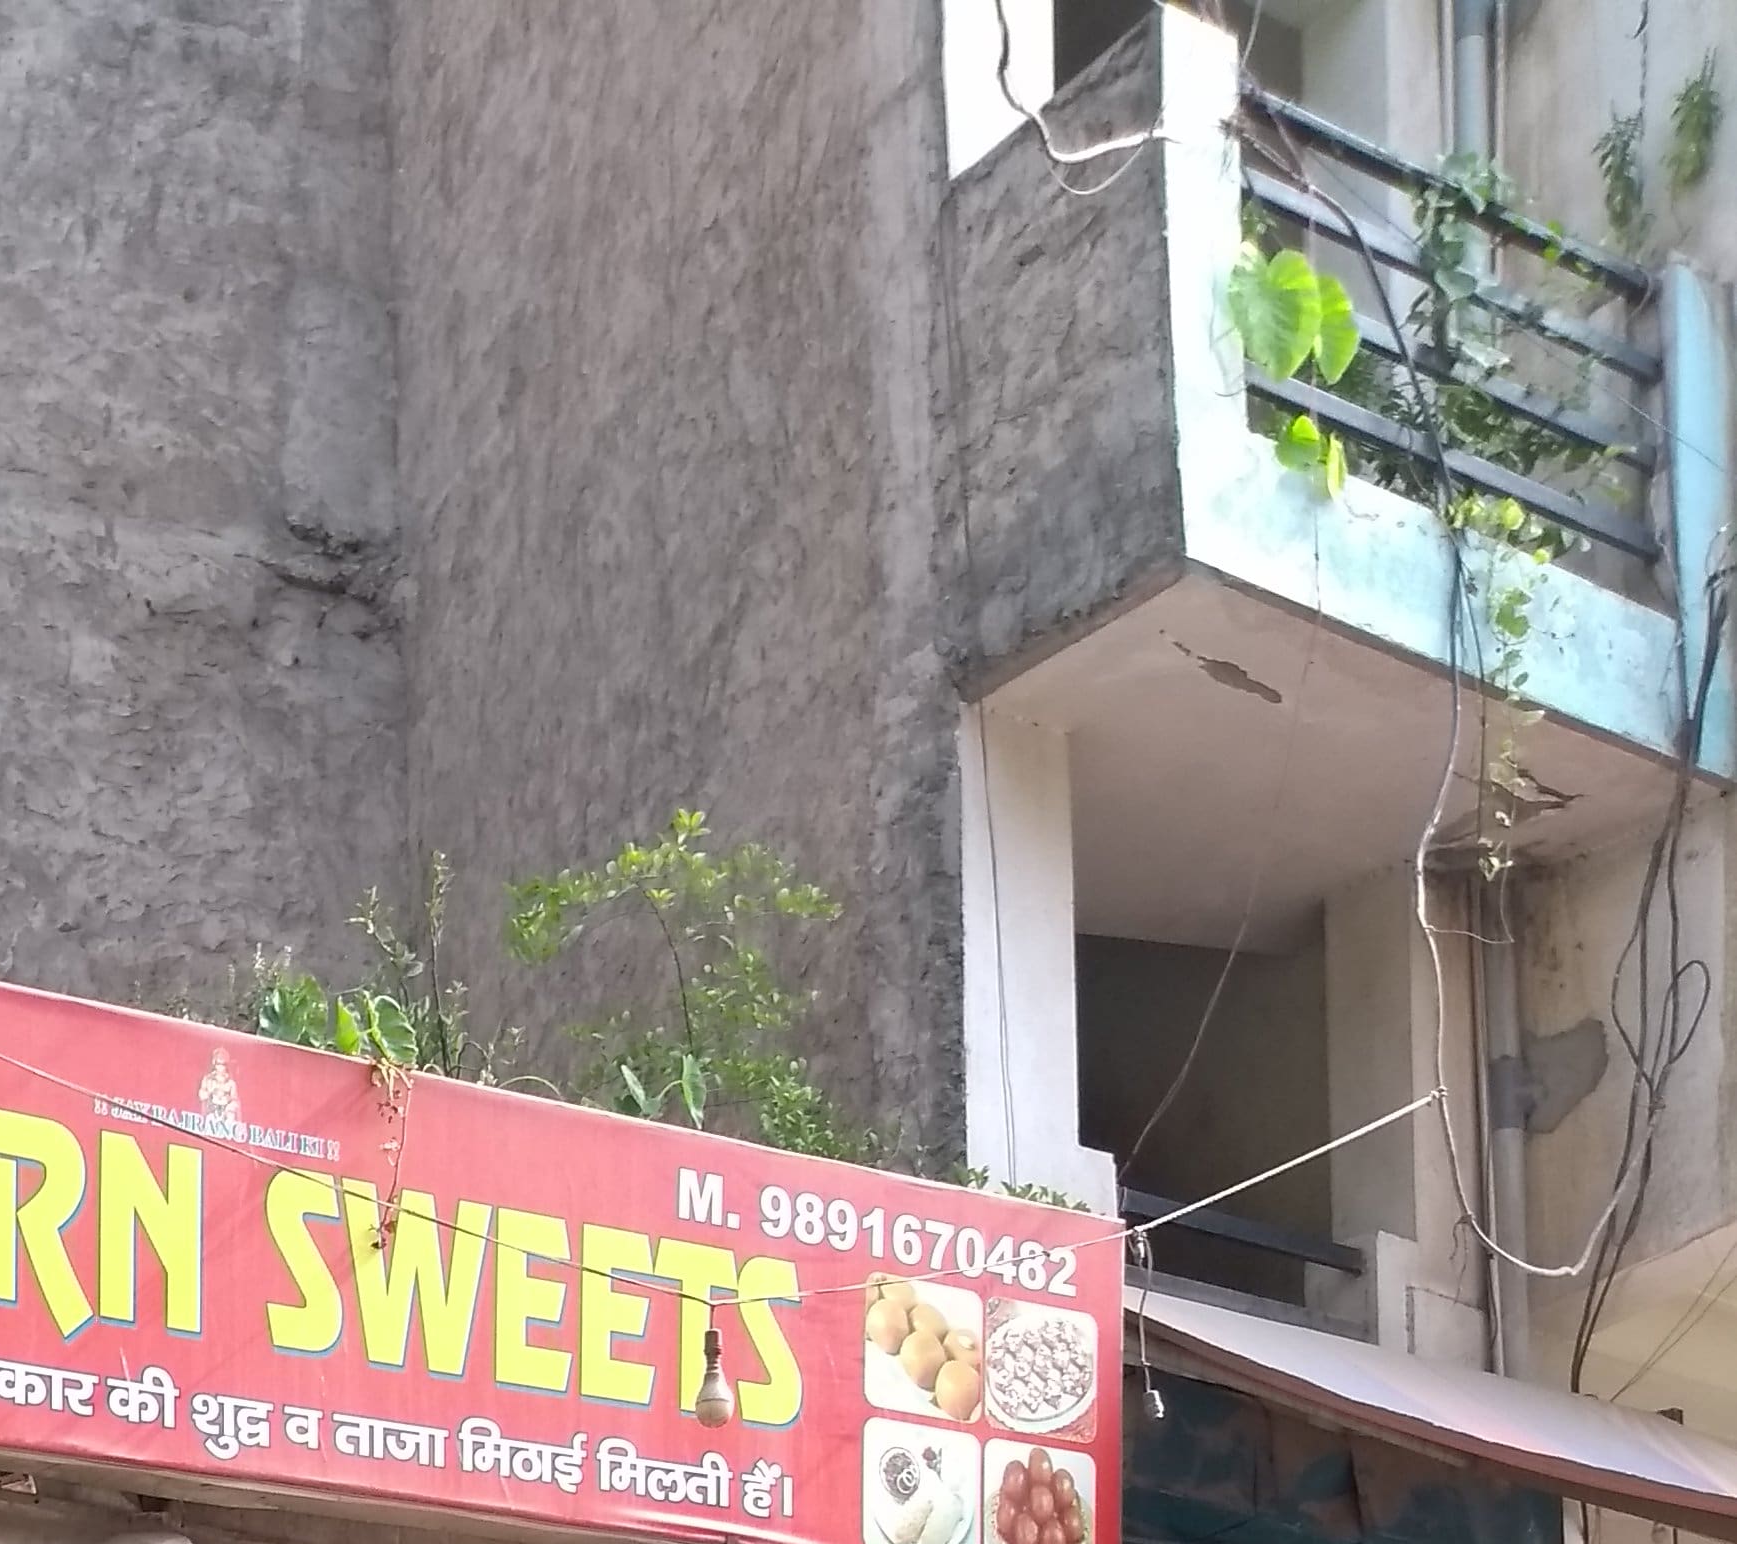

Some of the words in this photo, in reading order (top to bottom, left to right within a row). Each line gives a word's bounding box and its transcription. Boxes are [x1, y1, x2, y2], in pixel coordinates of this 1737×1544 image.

[248, 1124, 300, 1153] BALI
[300, 1134, 325, 1158] KI
[264, 1166, 805, 1434] SWEETS
[677, 1167, 741, 1230] M.
[760, 1186, 1079, 1298] 9891670482
[105, 1366, 181, 1431] की
[281, 1405, 323, 1452] व
[331, 1412, 450, 1469] ताजा
[458, 1417, 589, 1495] मिठाई
[596, 1437, 734, 1510] मिलती
